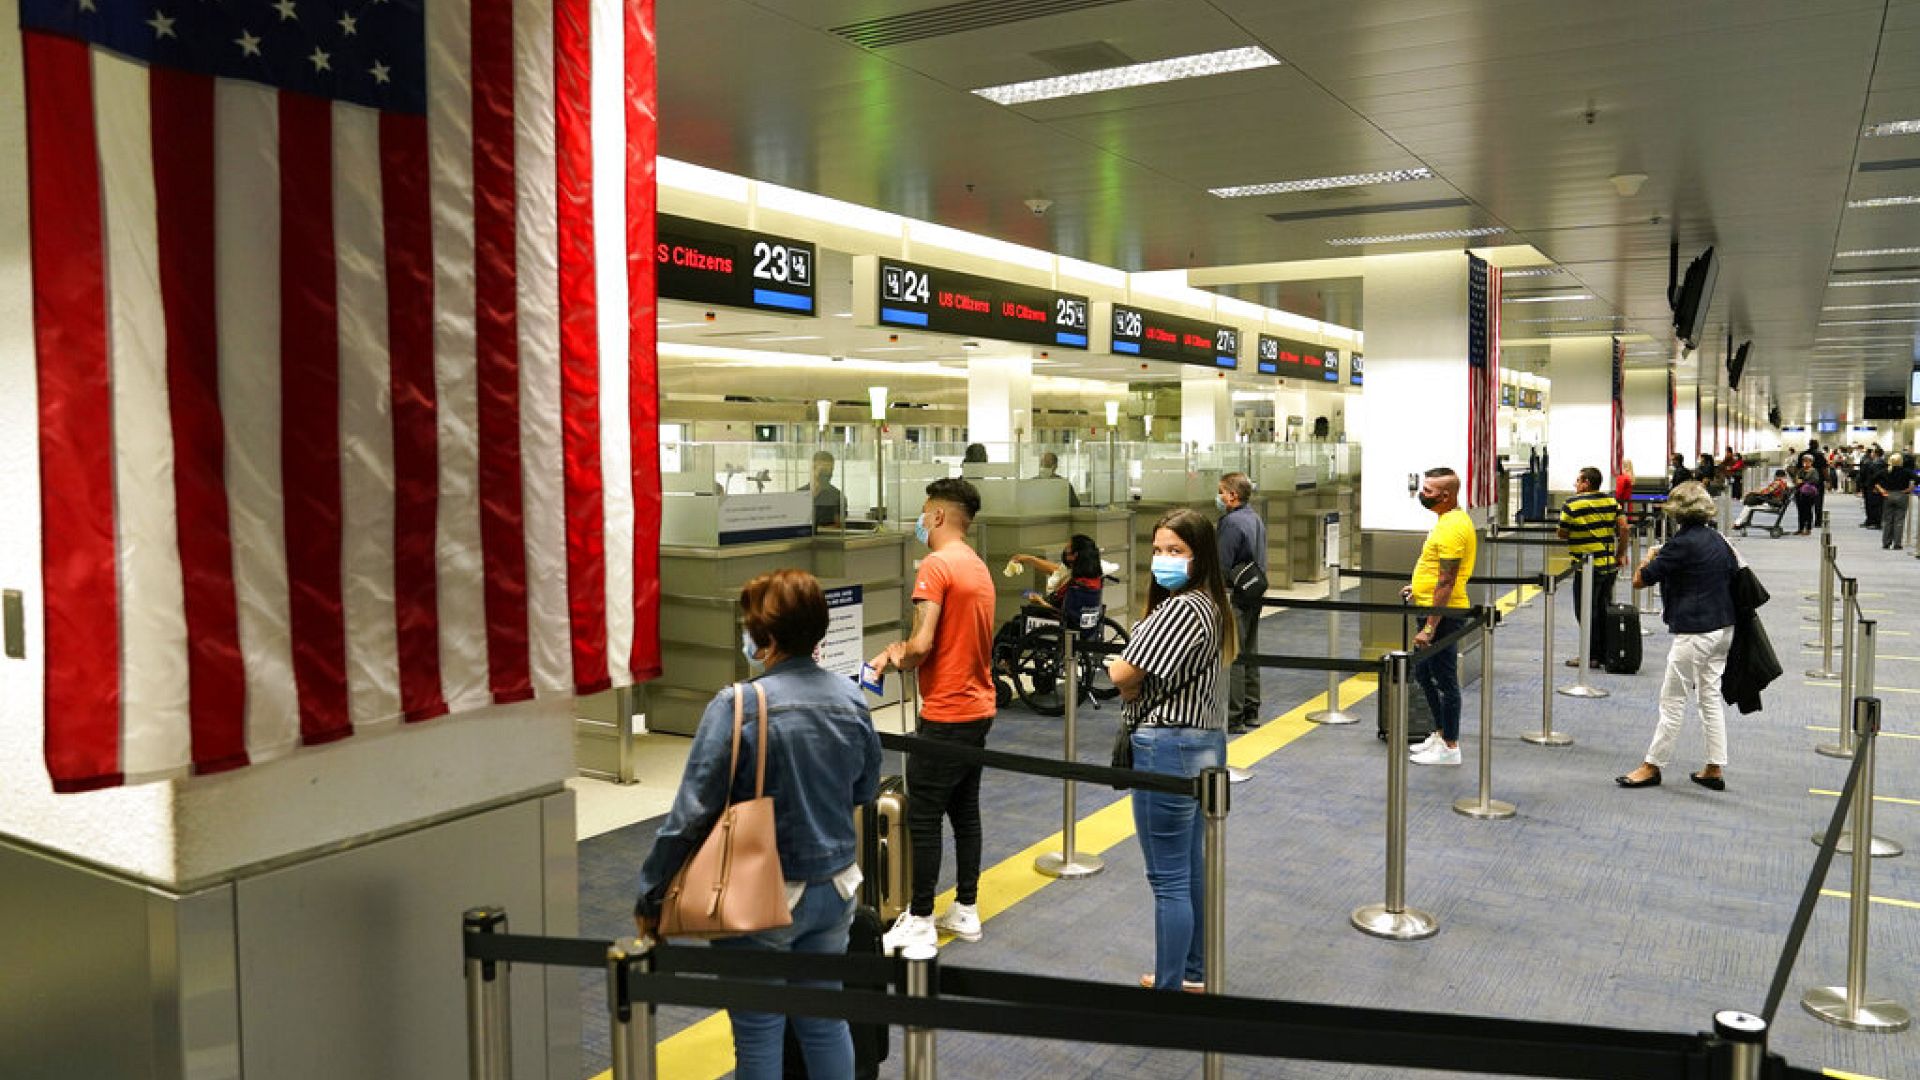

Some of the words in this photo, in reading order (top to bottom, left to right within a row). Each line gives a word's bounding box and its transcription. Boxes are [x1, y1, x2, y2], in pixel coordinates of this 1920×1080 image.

[658, 244, 670, 264] S
[673, 246, 733, 273] Citizens
[753, 241, 788, 281] 23
[904, 270, 930, 304] 24
[939, 290, 953, 308] US
[1056, 298, 1075, 326] 25
[1126, 311, 1142, 337] 26
